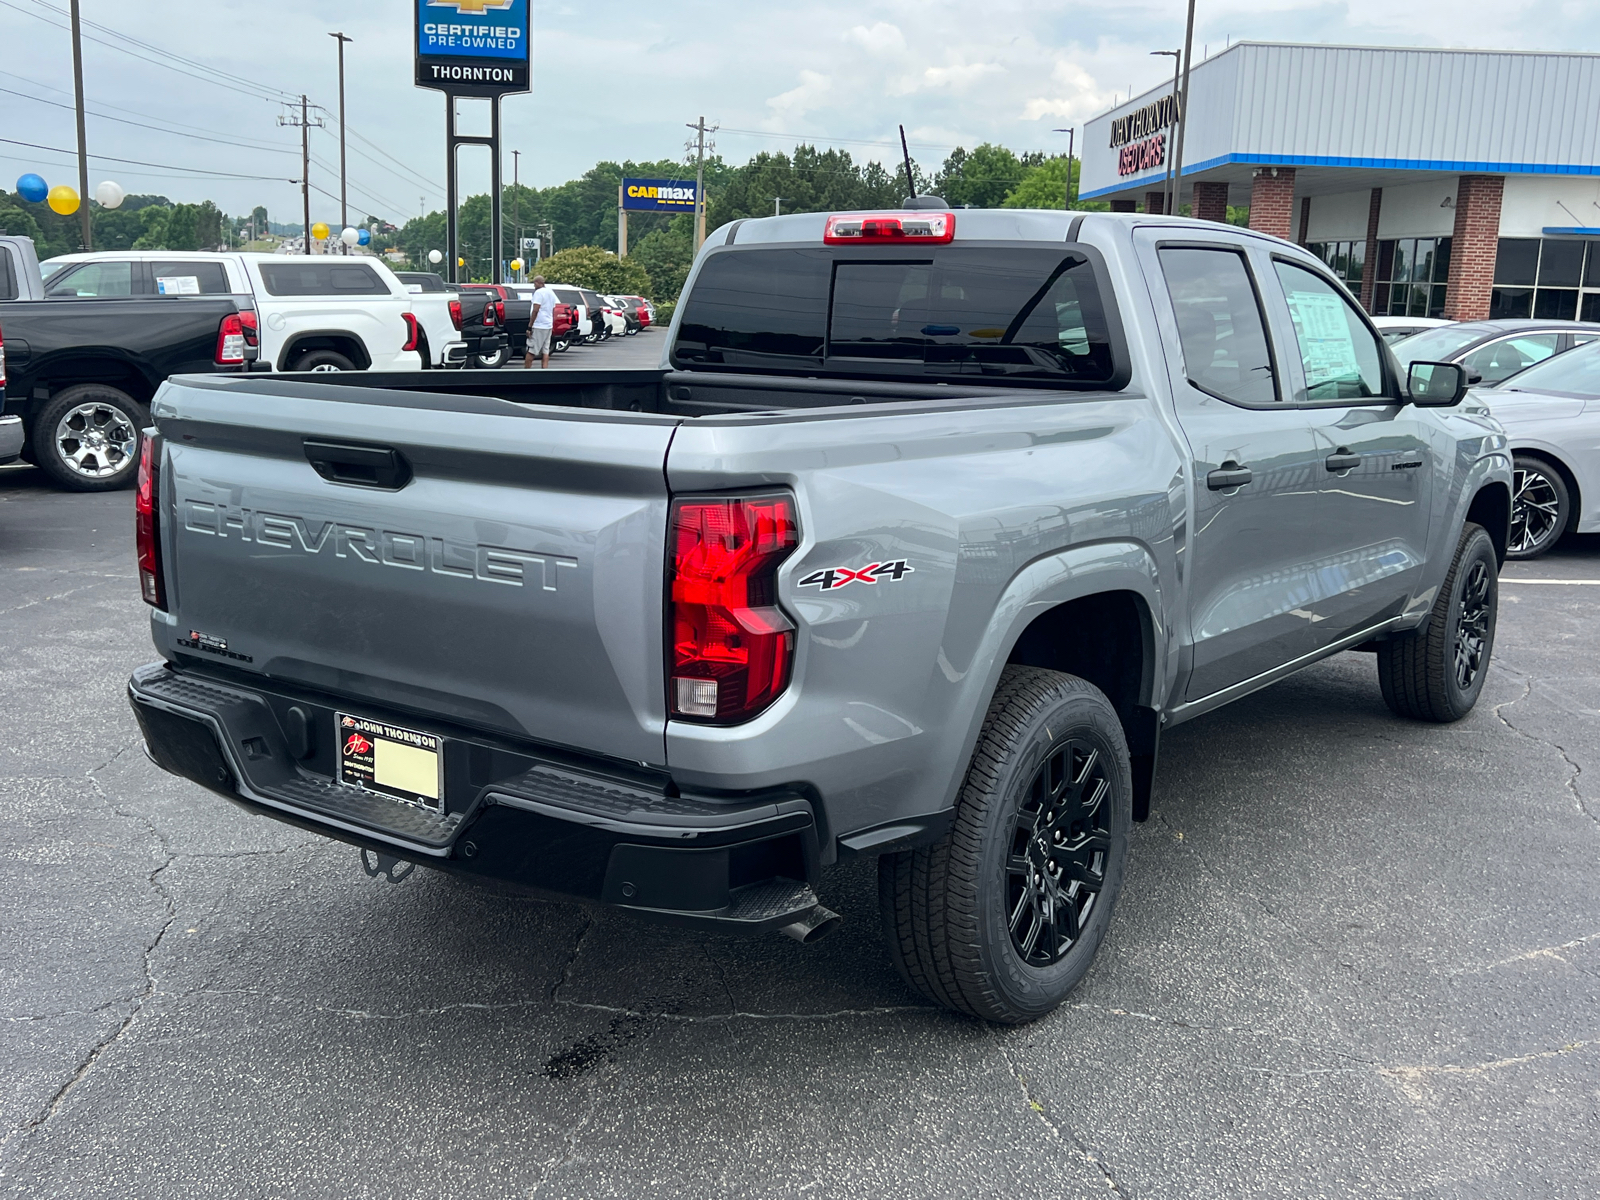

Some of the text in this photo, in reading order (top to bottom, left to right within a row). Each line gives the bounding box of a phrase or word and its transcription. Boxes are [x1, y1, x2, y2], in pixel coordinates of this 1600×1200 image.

[424, 23, 521, 38] CERTIFIED
[428, 35, 516, 50] PRE-OWNED
[431, 65, 513, 82] THORNTON
[1118, 133, 1166, 176] USED CARS
[627, 185, 695, 200] CARmax
[184, 498, 579, 593] CHEVROLET
[360, 720, 436, 748] JOHN THORNTON
